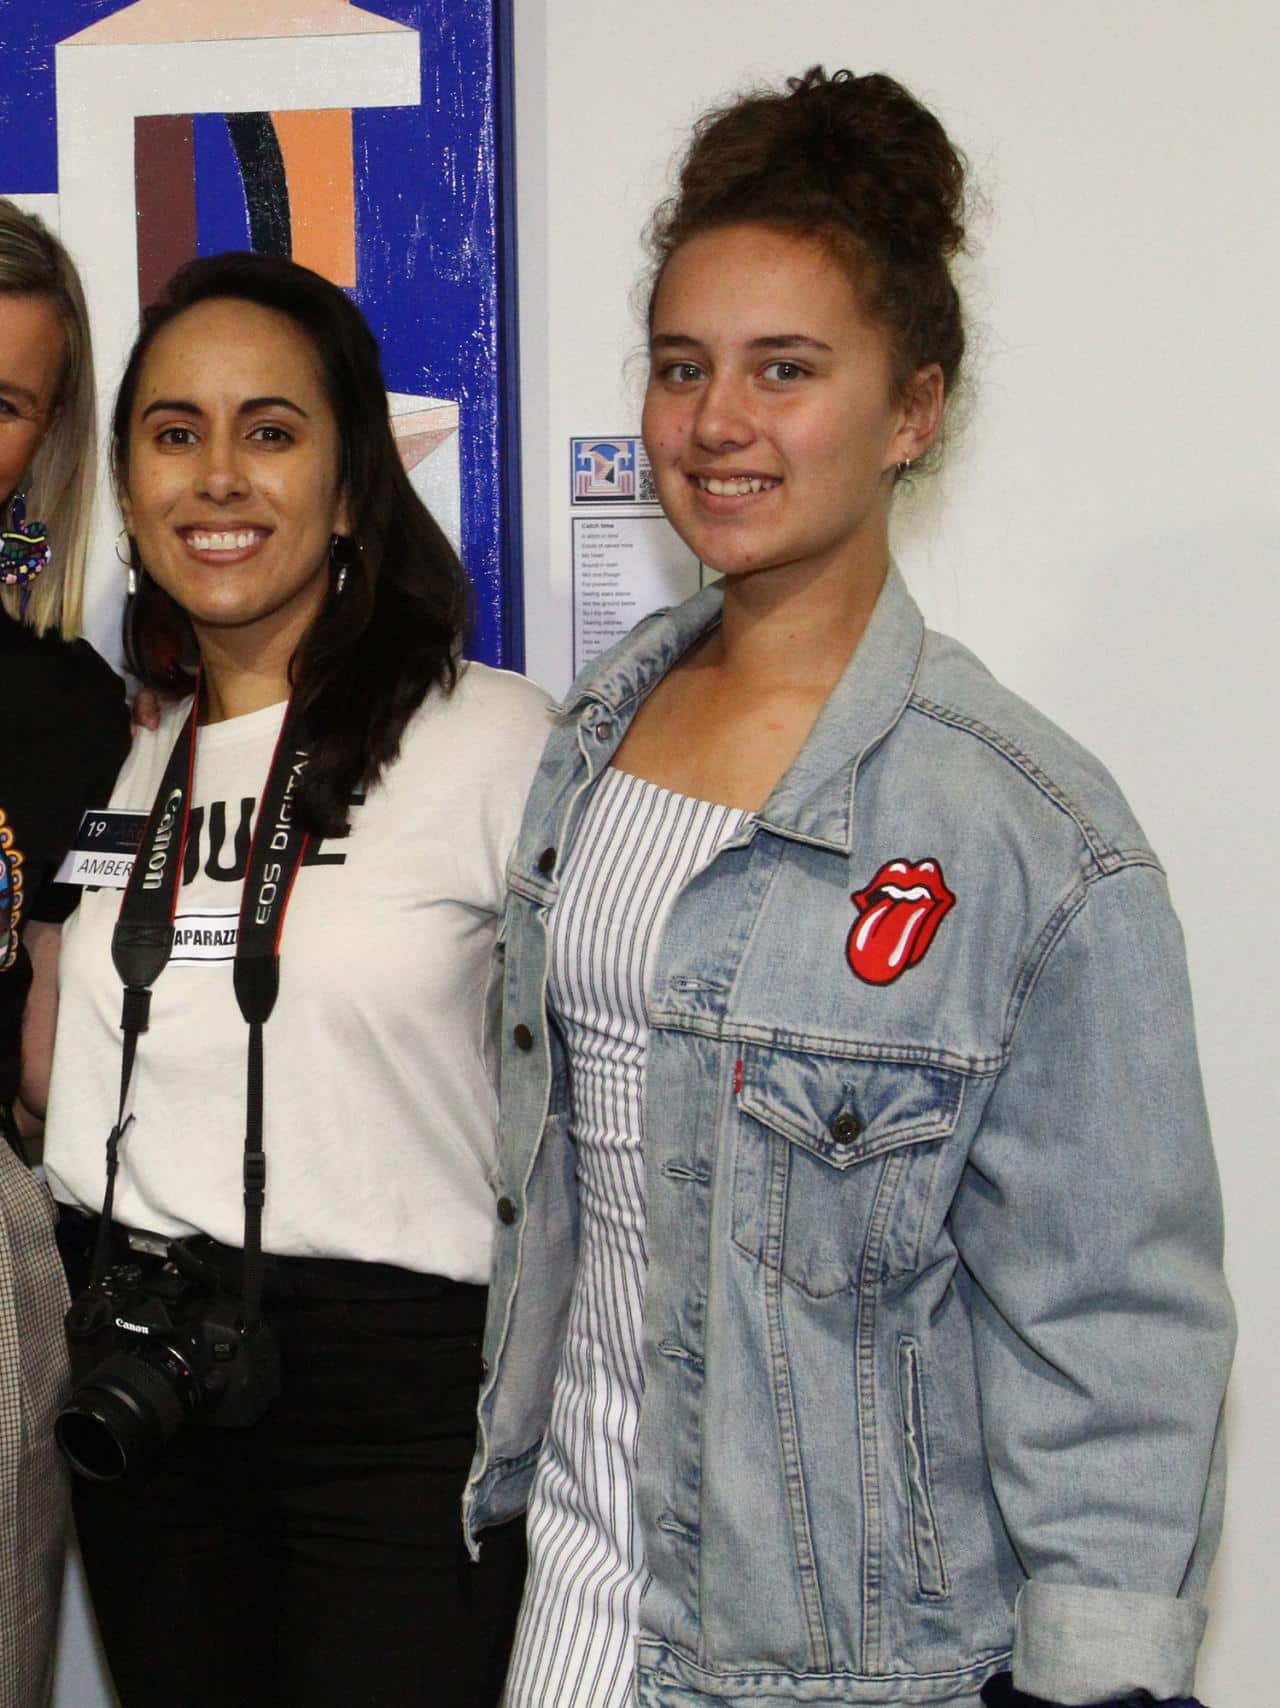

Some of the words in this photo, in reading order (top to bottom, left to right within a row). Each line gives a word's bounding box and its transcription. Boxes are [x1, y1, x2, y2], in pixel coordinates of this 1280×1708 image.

[87, 821, 107, 838] 19
[142, 788, 183, 890] Canon
[77, 858, 134, 877] AMBER
[256, 863, 281, 925] EOS
[174, 929, 236, 946] APARAZZ
[115, 1317, 149, 1335] Canon
